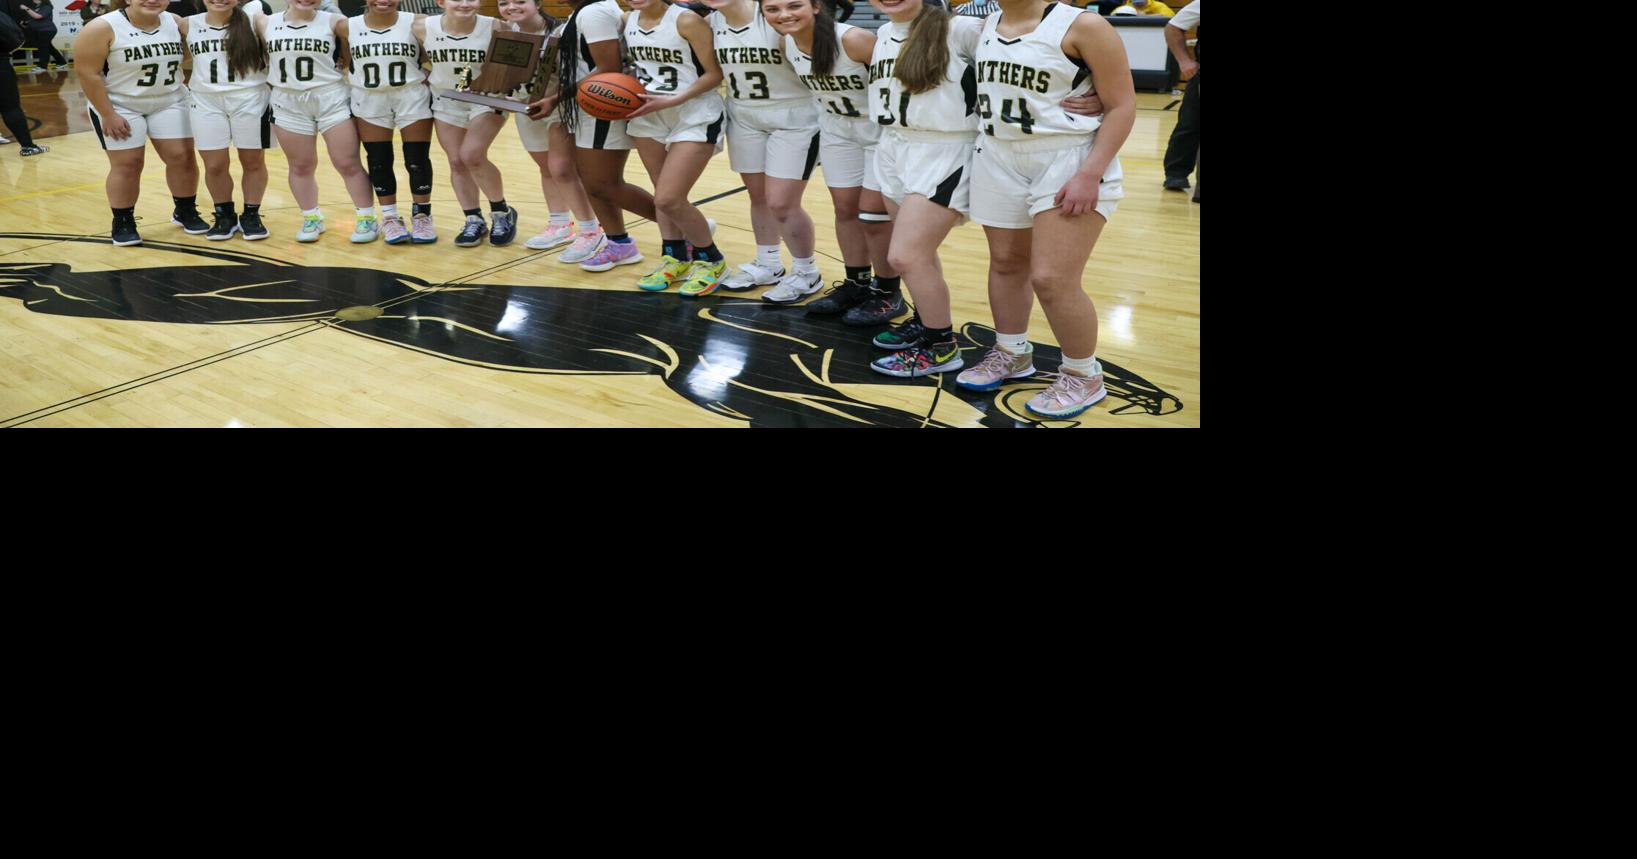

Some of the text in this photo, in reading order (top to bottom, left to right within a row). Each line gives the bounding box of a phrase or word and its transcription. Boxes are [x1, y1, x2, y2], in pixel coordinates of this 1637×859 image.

[267, 38, 330, 54] ANTHERS
[427, 48, 486, 63] PANTHER
[629, 46, 683, 64] NTHERS
[714, 47, 782, 64] NTHERS
[137, 60, 179, 87] 33
[279, 56, 314, 83] 10
[363, 61, 406, 88] 00
[977, 60, 1051, 94] NTHERS
[587, 84, 631, 105] Wilson
[729, 71, 770, 99] 13
[978, 93, 1035, 136] 24
